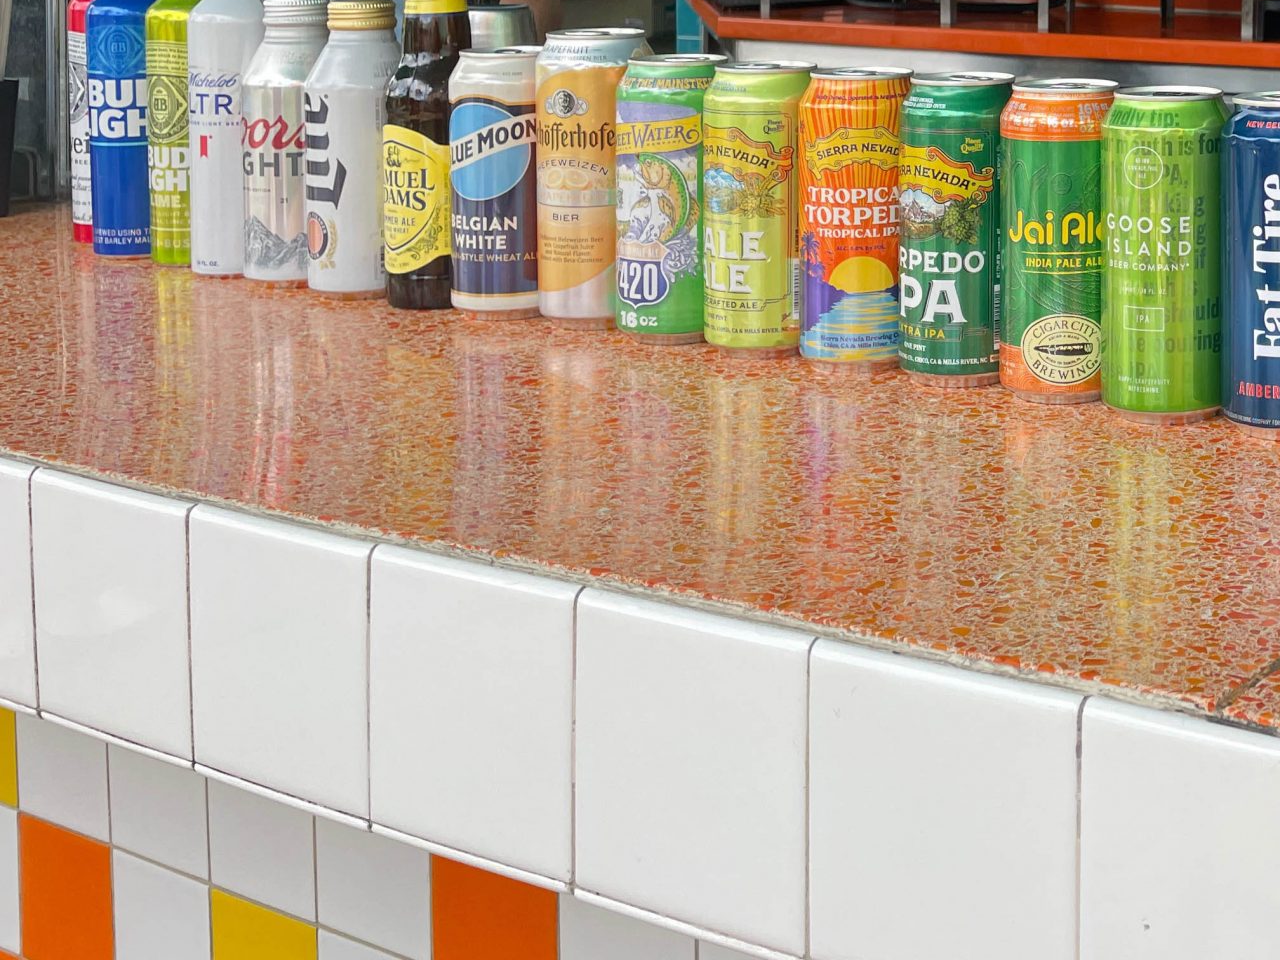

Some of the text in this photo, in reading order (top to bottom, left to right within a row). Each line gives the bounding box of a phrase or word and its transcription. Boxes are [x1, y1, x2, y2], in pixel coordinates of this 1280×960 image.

[188, 72, 237, 88] Michelob
[1246, 120, 1265, 129] NEW
[715, 145, 770, 169] NEVADA
[914, 165, 971, 190] NEVADA
[451, 214, 518, 231] BELGIAN
[553, 213, 580, 222] BIER
[1106, 213, 1191, 234] GOOSE
[454, 235, 507, 250] WHITE
[1107, 236, 1191, 257] ISLAND
[1109, 259, 1186, 272] BEER COMPANY
[619, 261, 659, 301] 420
[1032, 321, 1098, 339] CIGAR CITY
[1032, 359, 1095, 381] BREWING
[1238, 381, 1280, 400] AMBER
